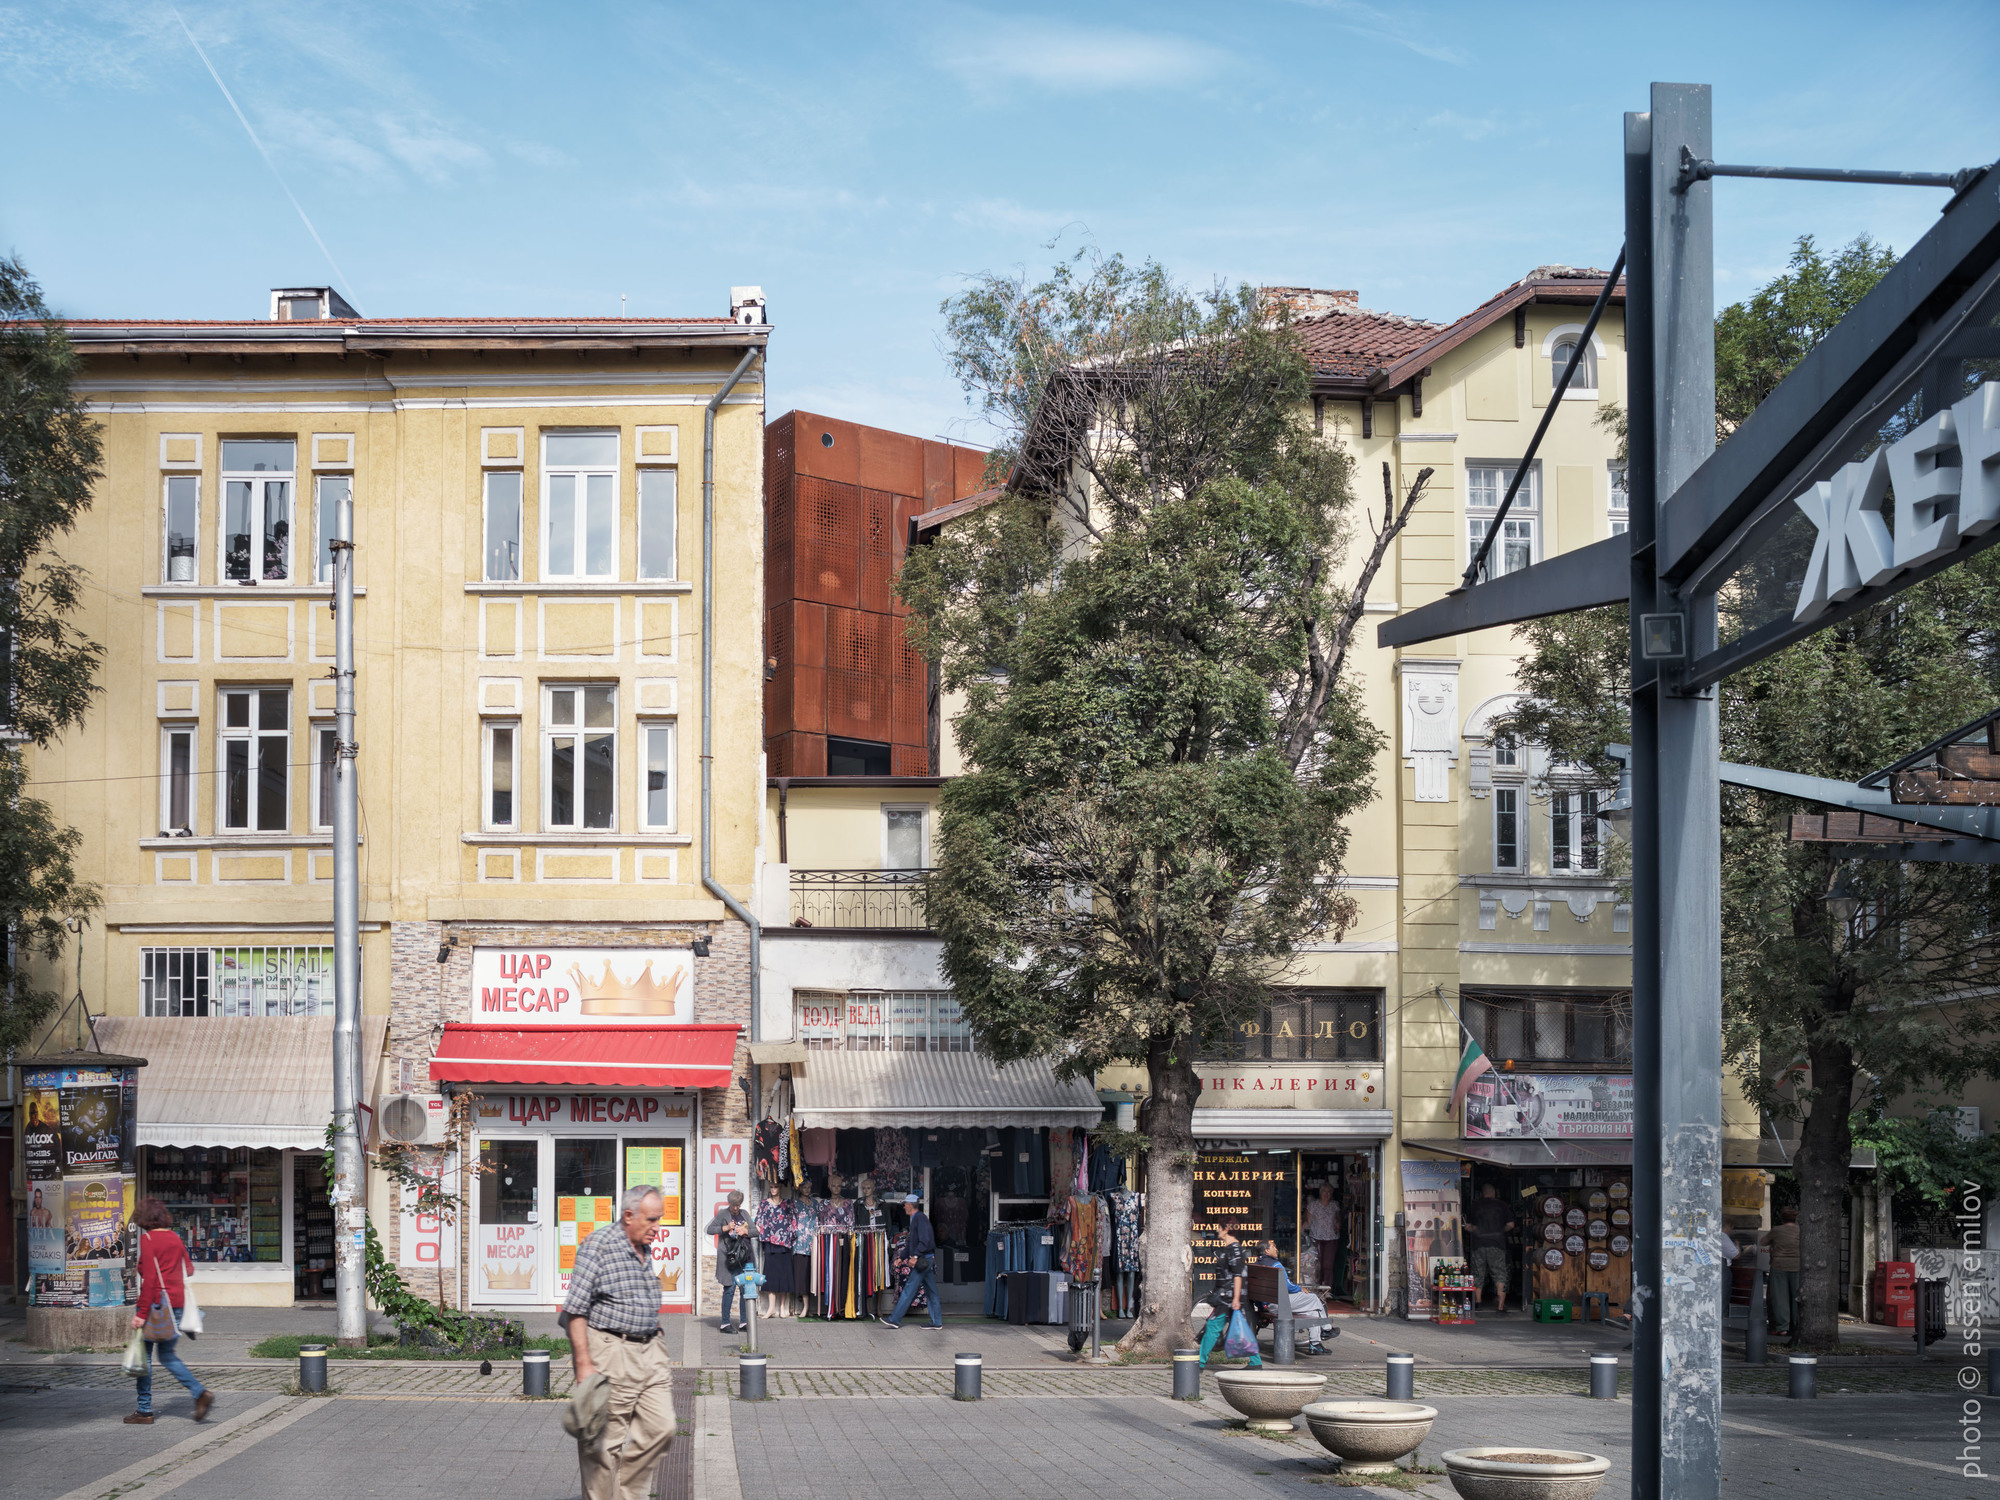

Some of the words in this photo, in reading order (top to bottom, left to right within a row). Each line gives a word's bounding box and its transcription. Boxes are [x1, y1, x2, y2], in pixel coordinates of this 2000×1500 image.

[266, 957, 329, 974] SNAIL
[500, 953, 552, 983] ЦАР
[481, 986, 570, 1013] МЕСАР
[849, 1004, 881, 1029] ВЕДА
[1200, 1078, 1357, 1091] НКАЛЕРИЯ
[509, 1096, 561, 1126] ЦАР
[570, 1096, 659, 1123] МЕСАР
[1563, 1112, 1608, 1121] НАЛИВНИ
[1562, 1124, 1612, 1134] ТЪРГОВИЯ
[1614, 1124, 1628, 1134] НА
[66, 1150, 119, 1165] БОДИГАРД
[1204, 1155, 1250, 1163] ПРЕЖДА
[1194, 1171, 1285, 1181] НКАЛЕРИЯ
[1203, 1190, 1252, 1198] КОПЧЕТА
[69, 1200, 120, 1210] Комеди
[1206, 1206, 1249, 1215] ЦИПОВЕ
[80, 1210, 112, 1220] Клуб
[496, 1226, 525, 1243] ЦАР
[650, 1228, 670, 1243] АР
[486, 1245, 535, 1259] МЕСАР
[651, 1246, 680, 1261] САР
